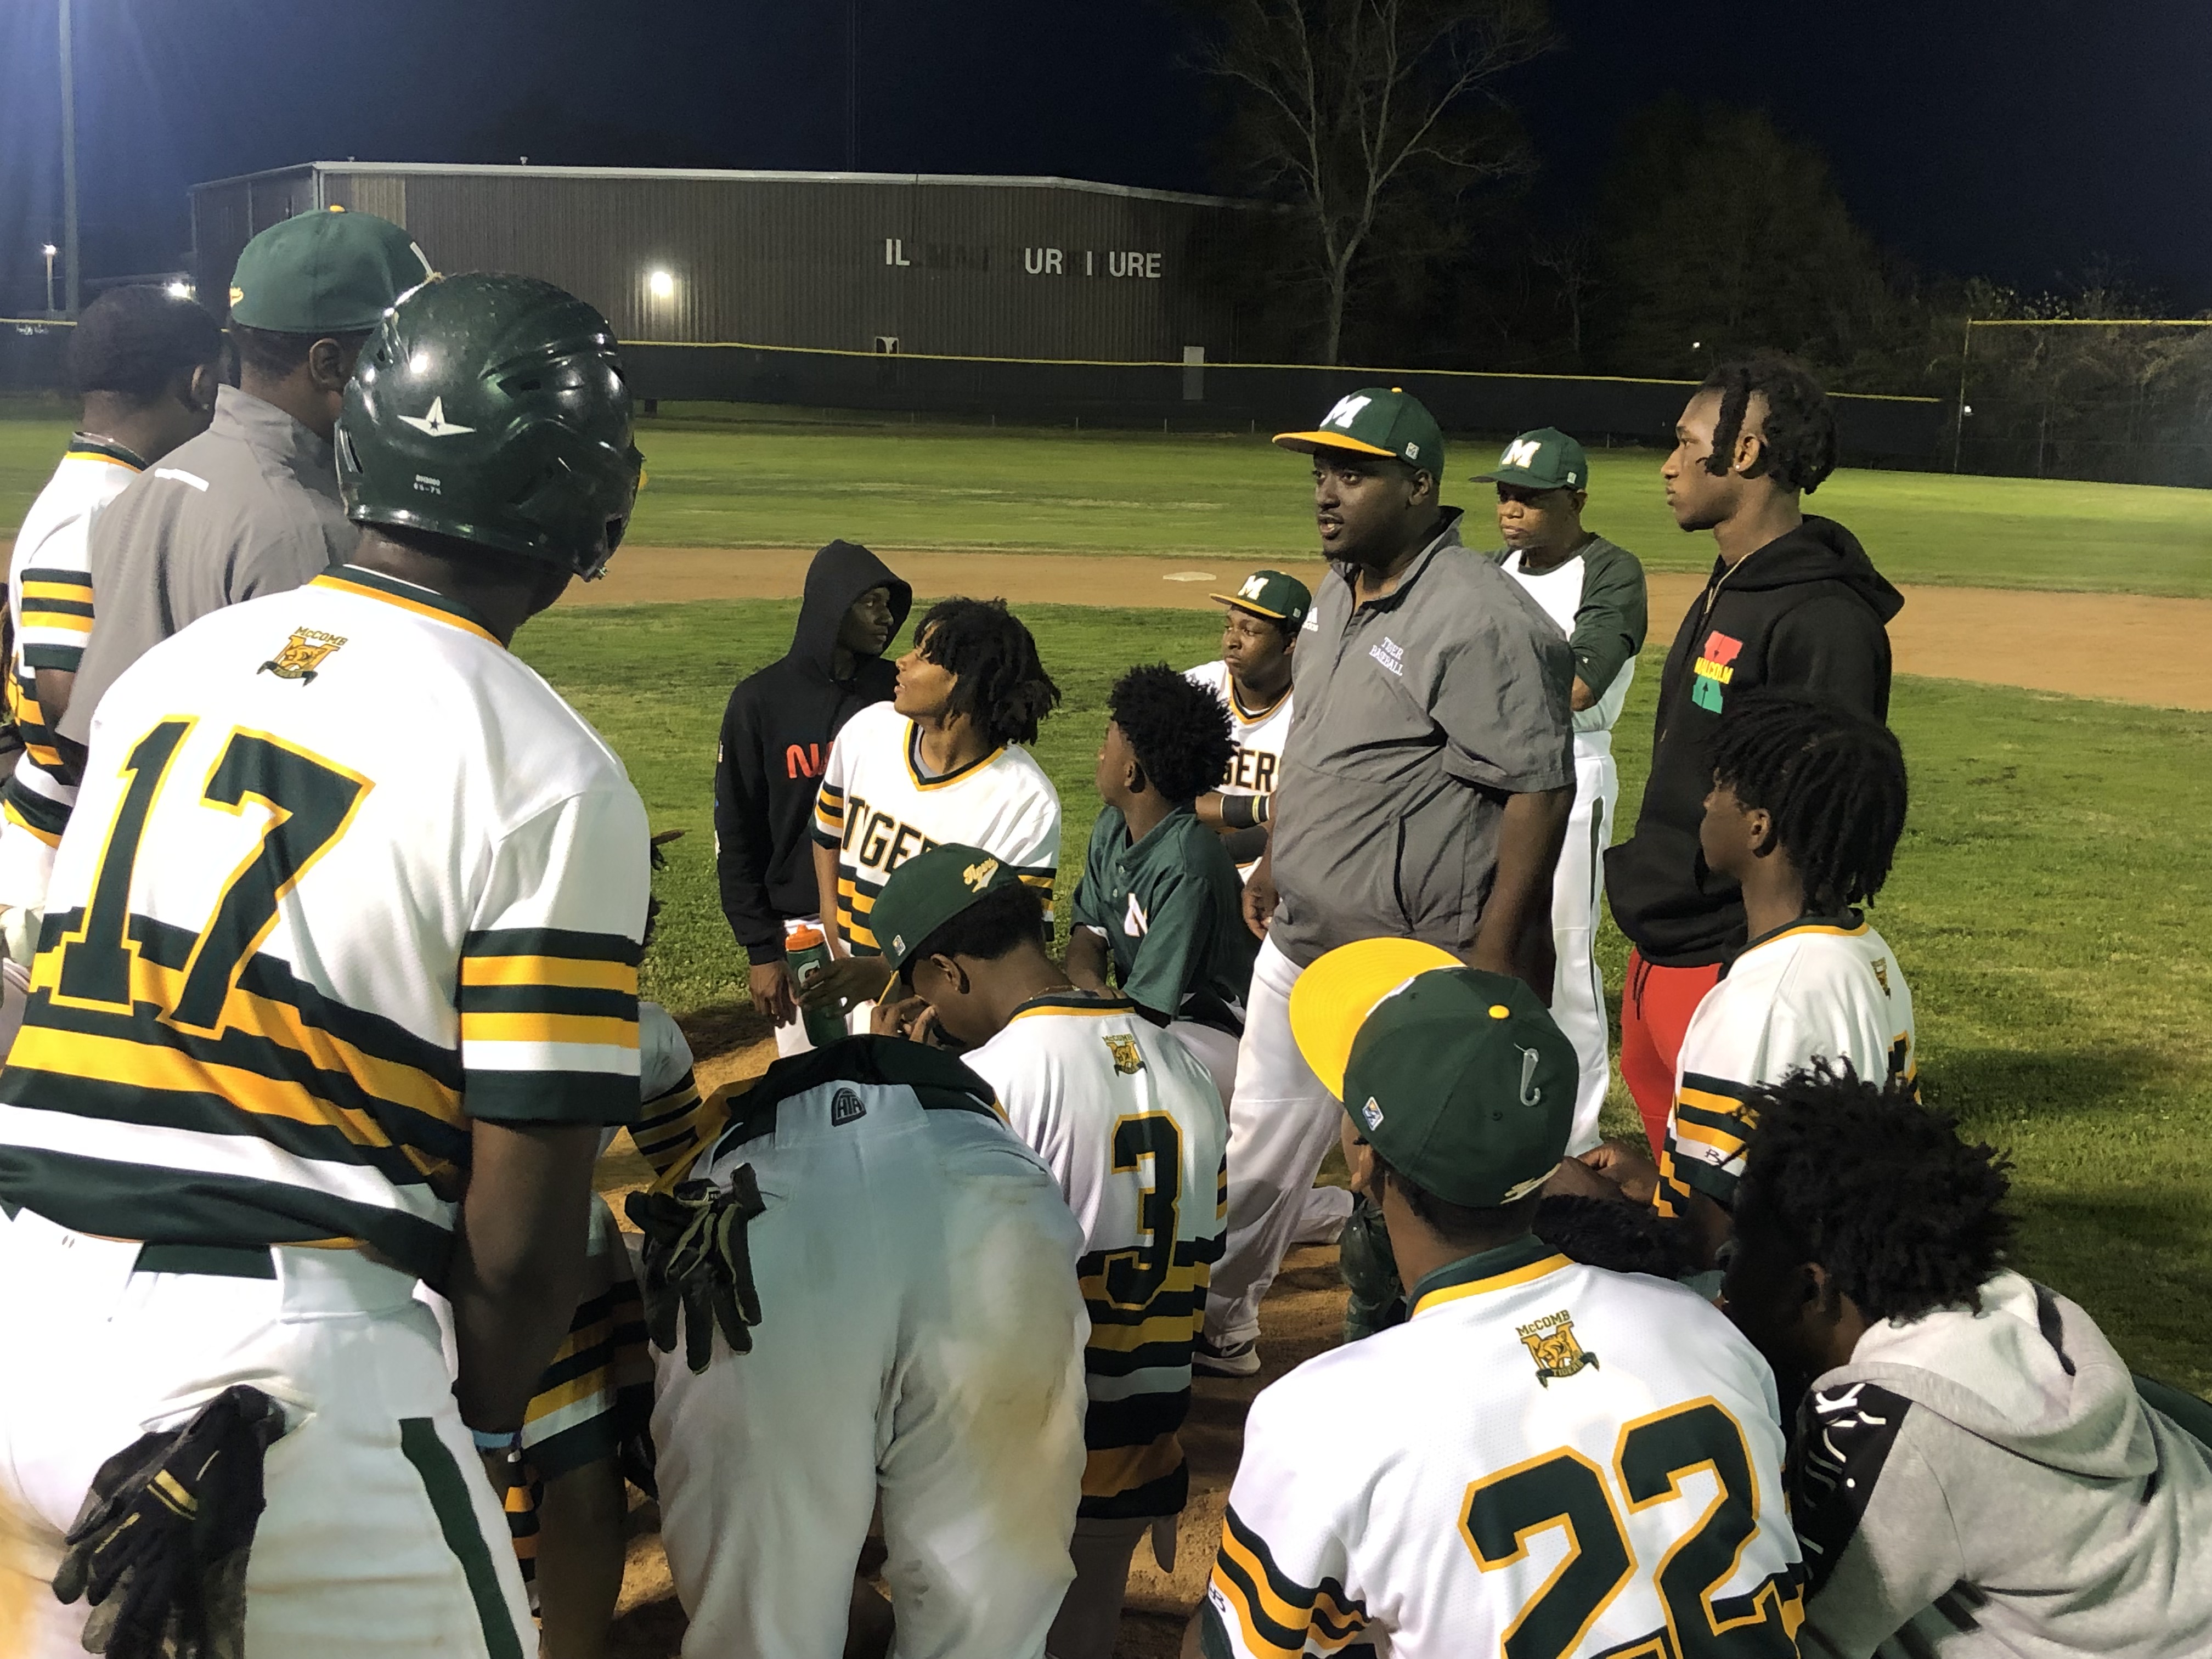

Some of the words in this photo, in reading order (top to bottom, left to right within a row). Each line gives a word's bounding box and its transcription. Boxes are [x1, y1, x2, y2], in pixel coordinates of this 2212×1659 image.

[1319, 394, 1372, 429] M
[1501, 439, 1542, 469] M
[1237, 574, 1269, 601] M
[294, 625, 349, 646] McCOMB
[1694, 656, 1734, 685] MALCOLM
[49, 715, 376, 1041] 17
[1103, 1110, 1183, 1311] 3
[1515, 1310, 1571, 1336] McCOMB
[1458, 1395, 1801, 1659] 22
